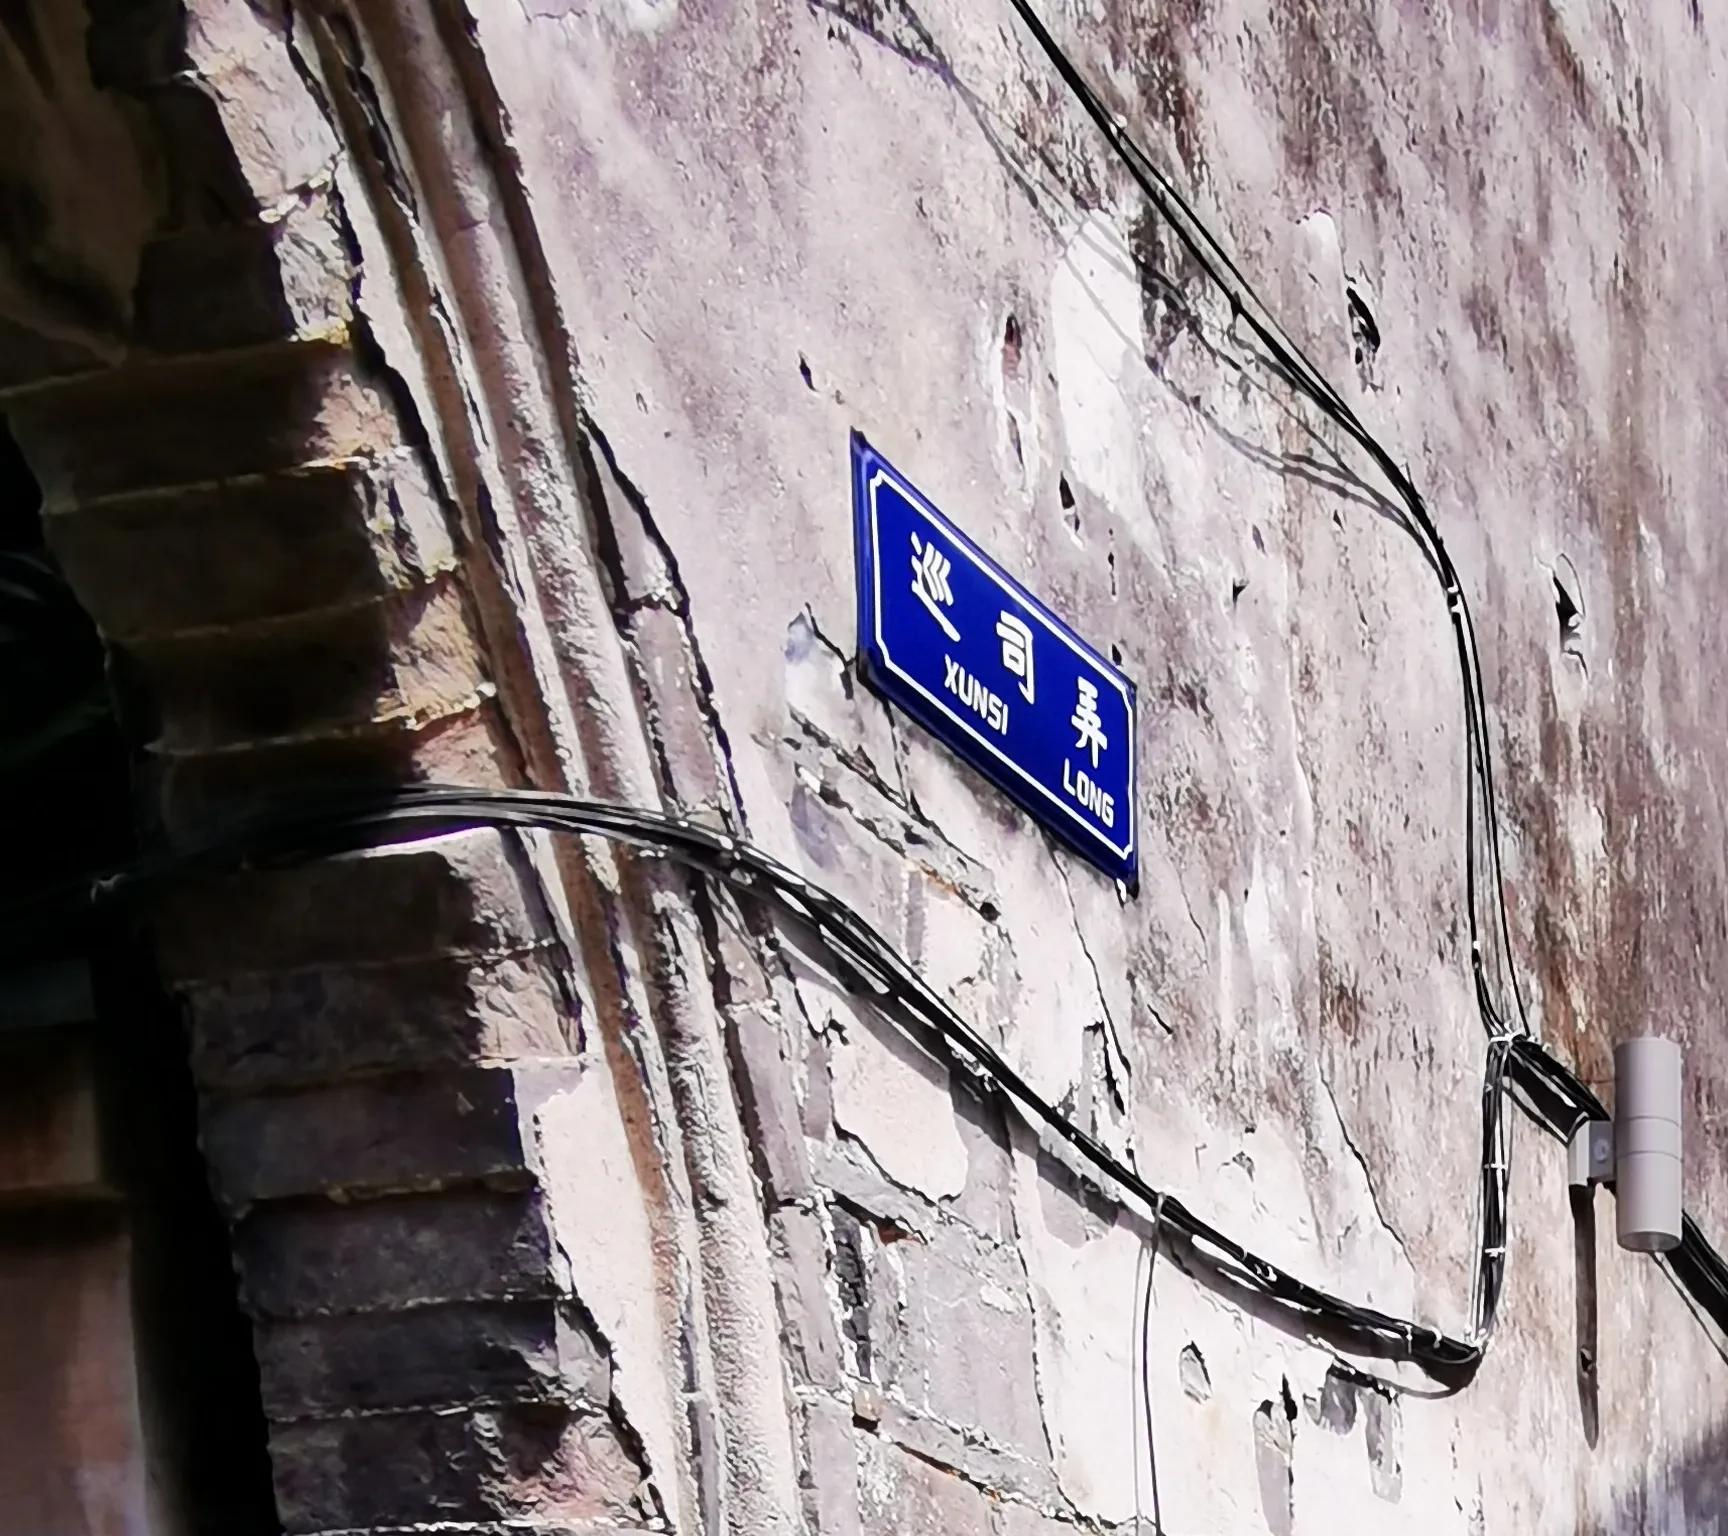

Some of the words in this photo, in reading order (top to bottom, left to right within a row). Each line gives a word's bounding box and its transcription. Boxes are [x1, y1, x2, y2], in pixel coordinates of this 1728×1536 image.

[911, 531, 1107, 768] 巡司弄
[944, 654, 1009, 736] XUNSI
[1062, 758, 1115, 828] LONG
